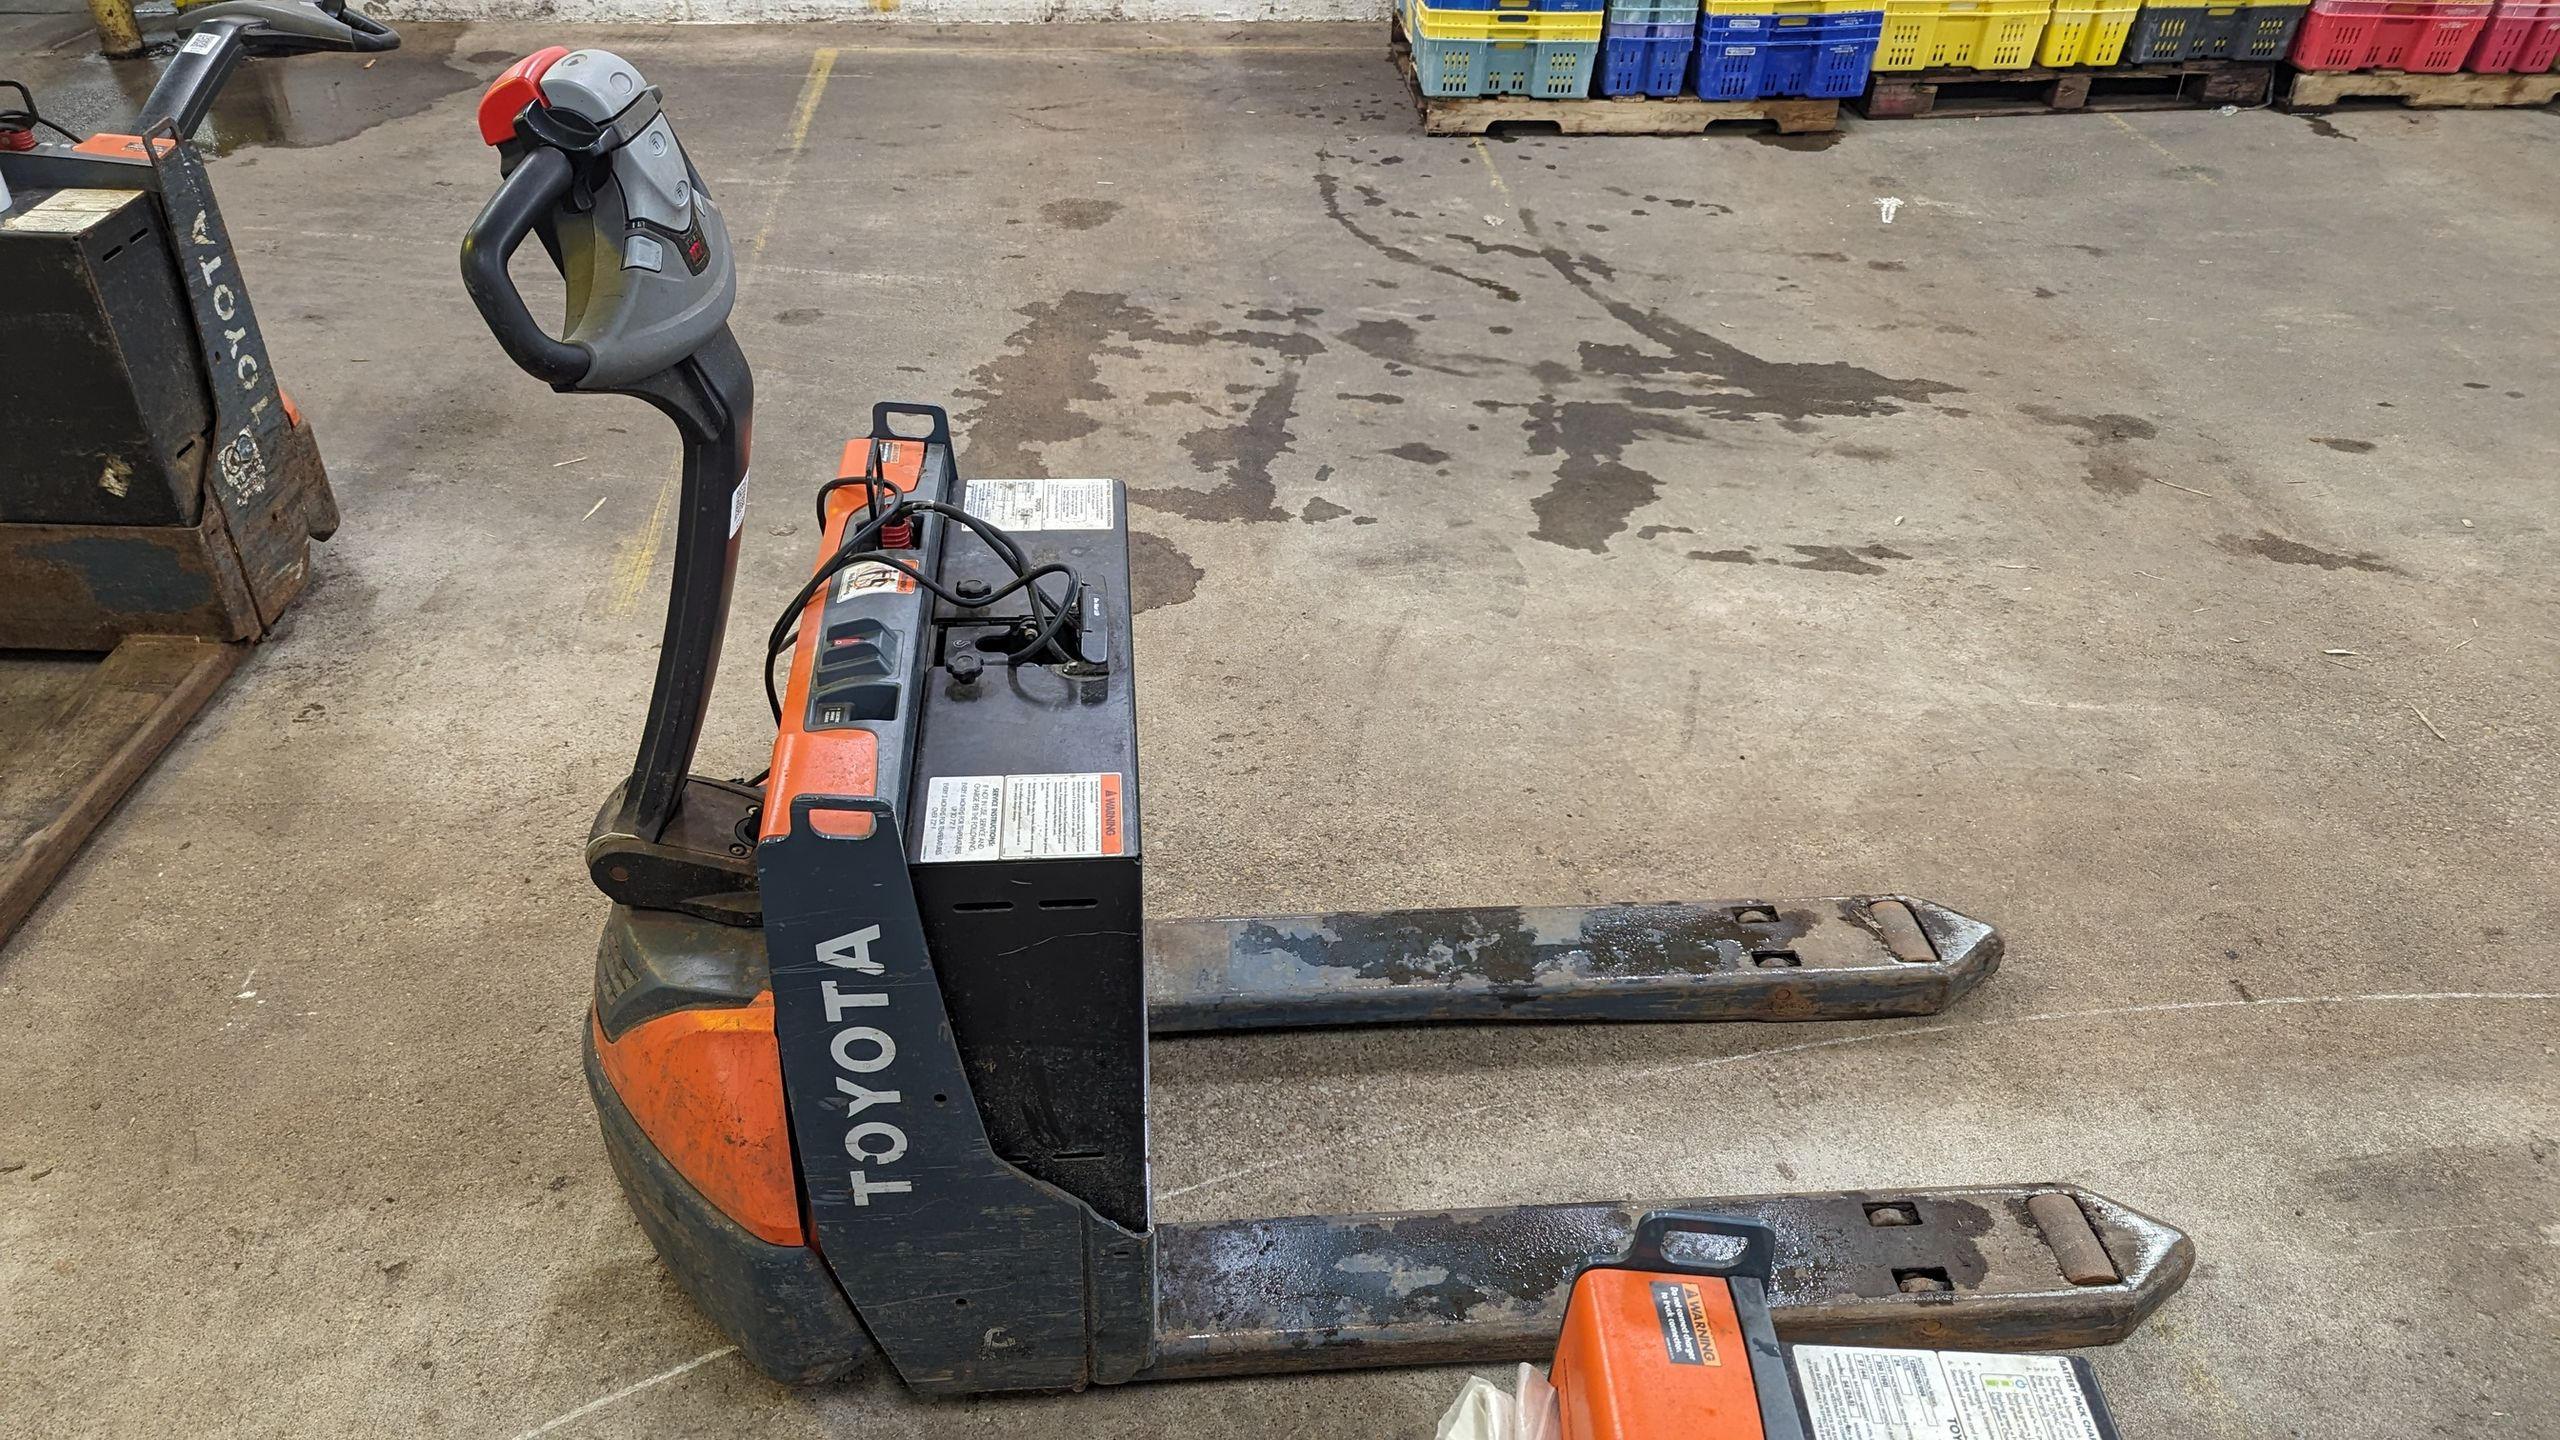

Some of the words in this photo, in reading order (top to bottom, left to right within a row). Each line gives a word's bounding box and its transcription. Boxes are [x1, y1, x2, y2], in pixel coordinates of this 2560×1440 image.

[191, 209, 269, 425] TOYOTA
[973, 783, 981, 802] CHARGE
[991, 788, 999, 806] SERVICE
[971, 812, 979, 821] THE
[1105, 798, 1116, 836] WARNING
[978, 818, 986, 836] SERVICE
[988, 808, 997, 846] INSTRUCTIONS:
[815, 923, 912, 1207] TOYOTA
[1670, 1287, 1679, 1296] Do
[1663, 1300, 1674, 1317] truck
[1673, 1297, 1682, 1308] not
[1676, 1309, 1689, 1334] connect
[1689, 1301, 1715, 1361] WARNING
[1683, 1334, 1696, 1360] charger
[1918, 1357, 1927, 1377] BATTERY
[2053, 1376, 2064, 1395] Charge
[2059, 1360, 2078, 1393] BATTERY
[2073, 1396, 2087, 1417] PACK
